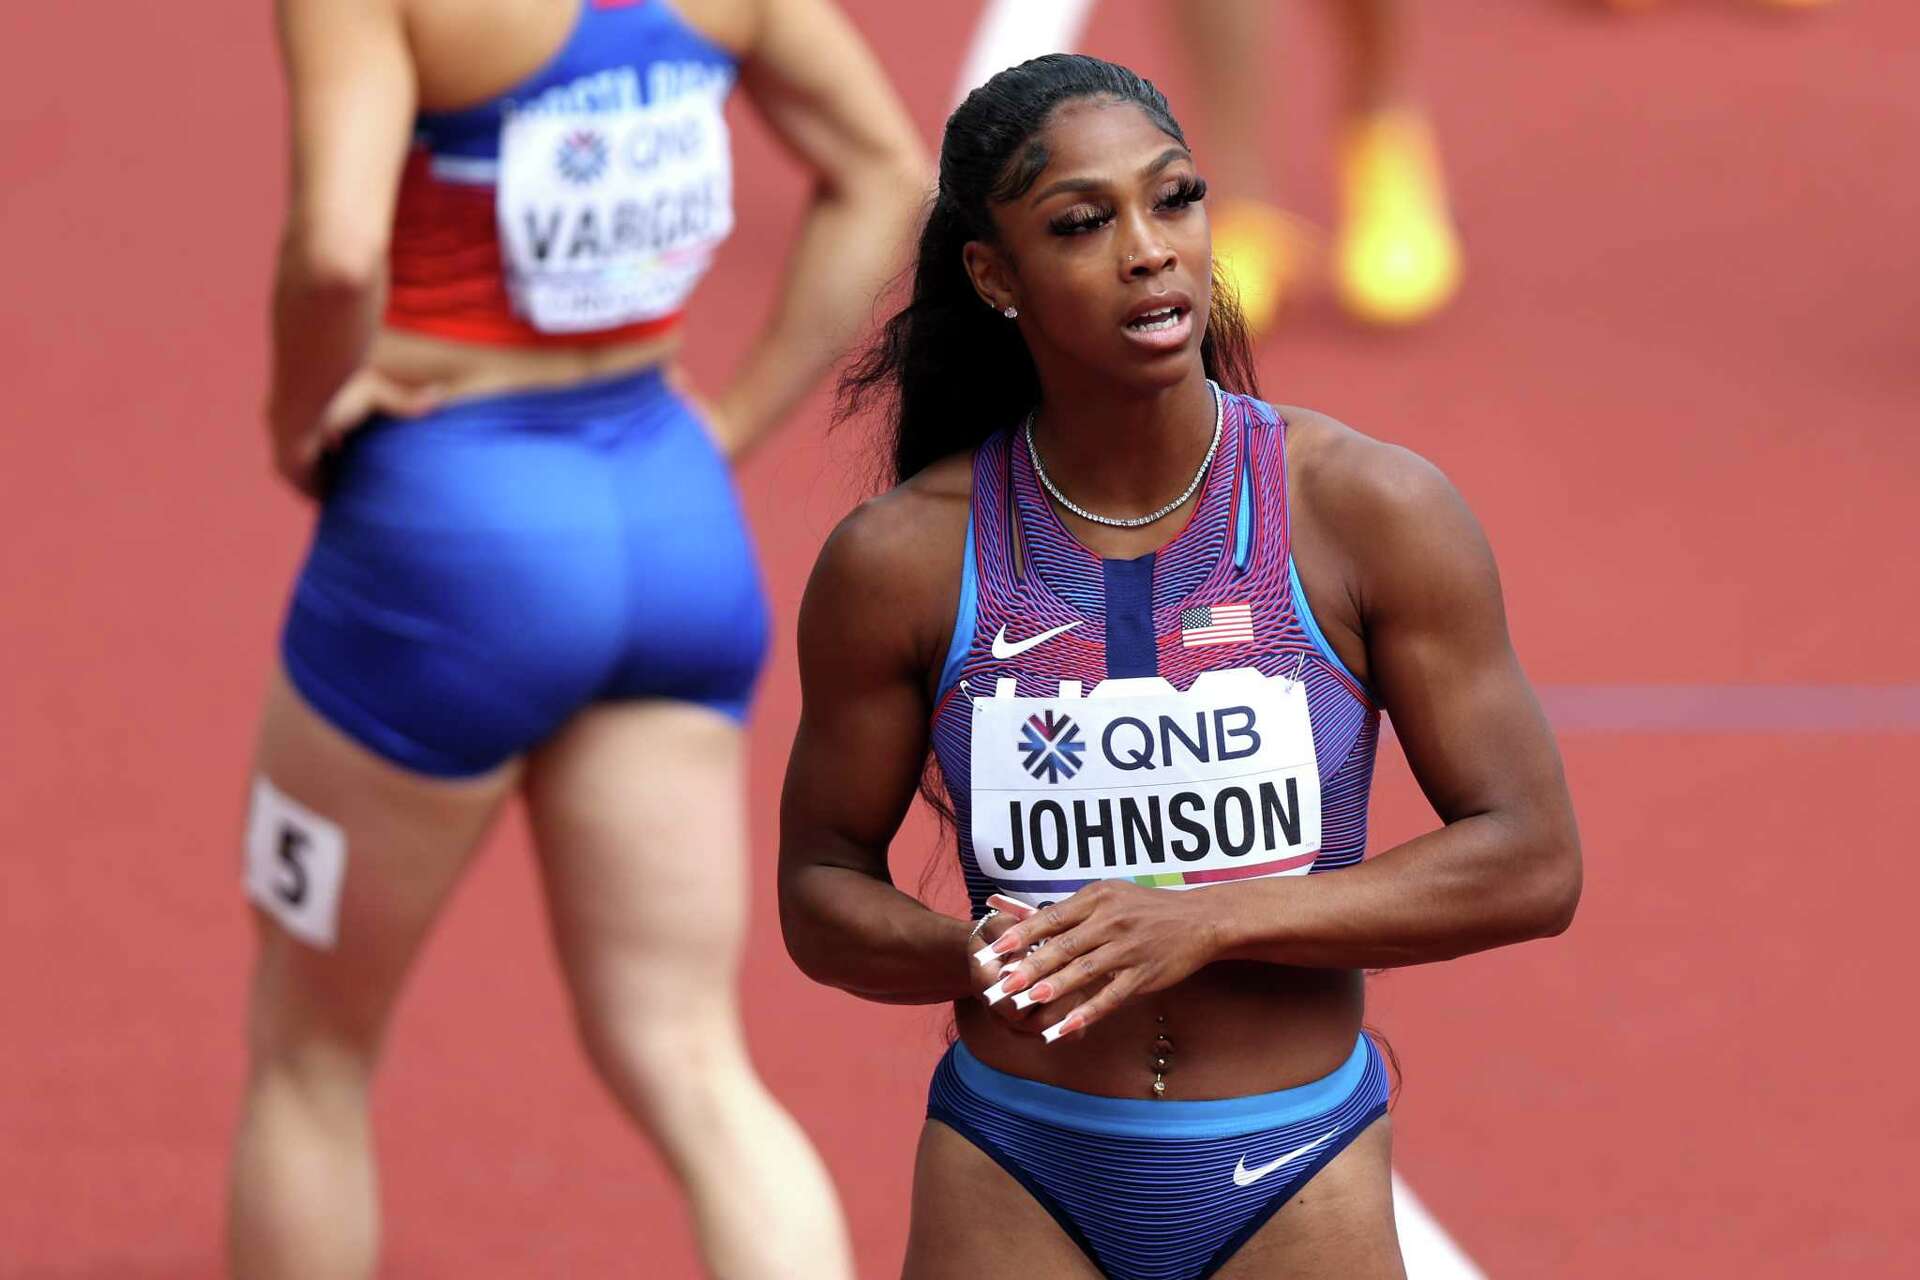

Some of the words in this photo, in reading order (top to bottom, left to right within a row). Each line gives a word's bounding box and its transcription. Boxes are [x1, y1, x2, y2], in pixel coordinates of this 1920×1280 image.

[1101, 705, 1262, 771] QNB
[275, 822, 313, 908] 5
[993, 777, 1302, 871] JOHNSON
